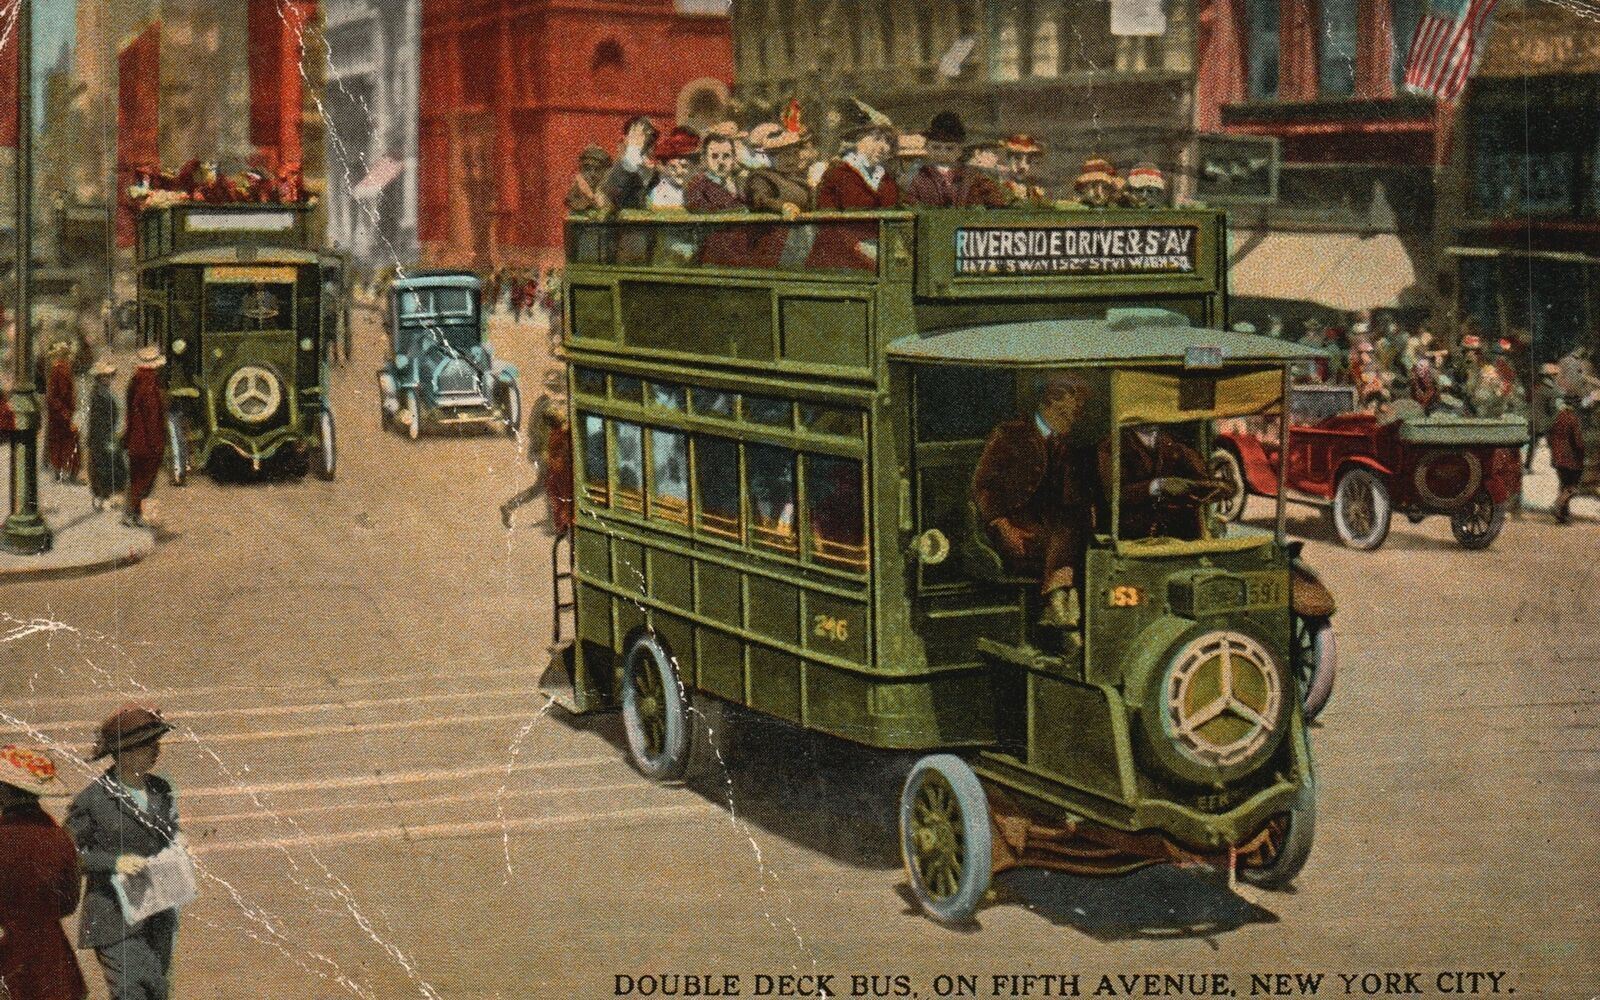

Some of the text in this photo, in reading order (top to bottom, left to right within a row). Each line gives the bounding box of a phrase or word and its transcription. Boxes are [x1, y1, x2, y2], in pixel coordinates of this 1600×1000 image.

[956, 230, 1062, 257] RIVERSIDE
[1065, 230, 1125, 256] DRIVE
[1126, 229, 1144, 256] &
